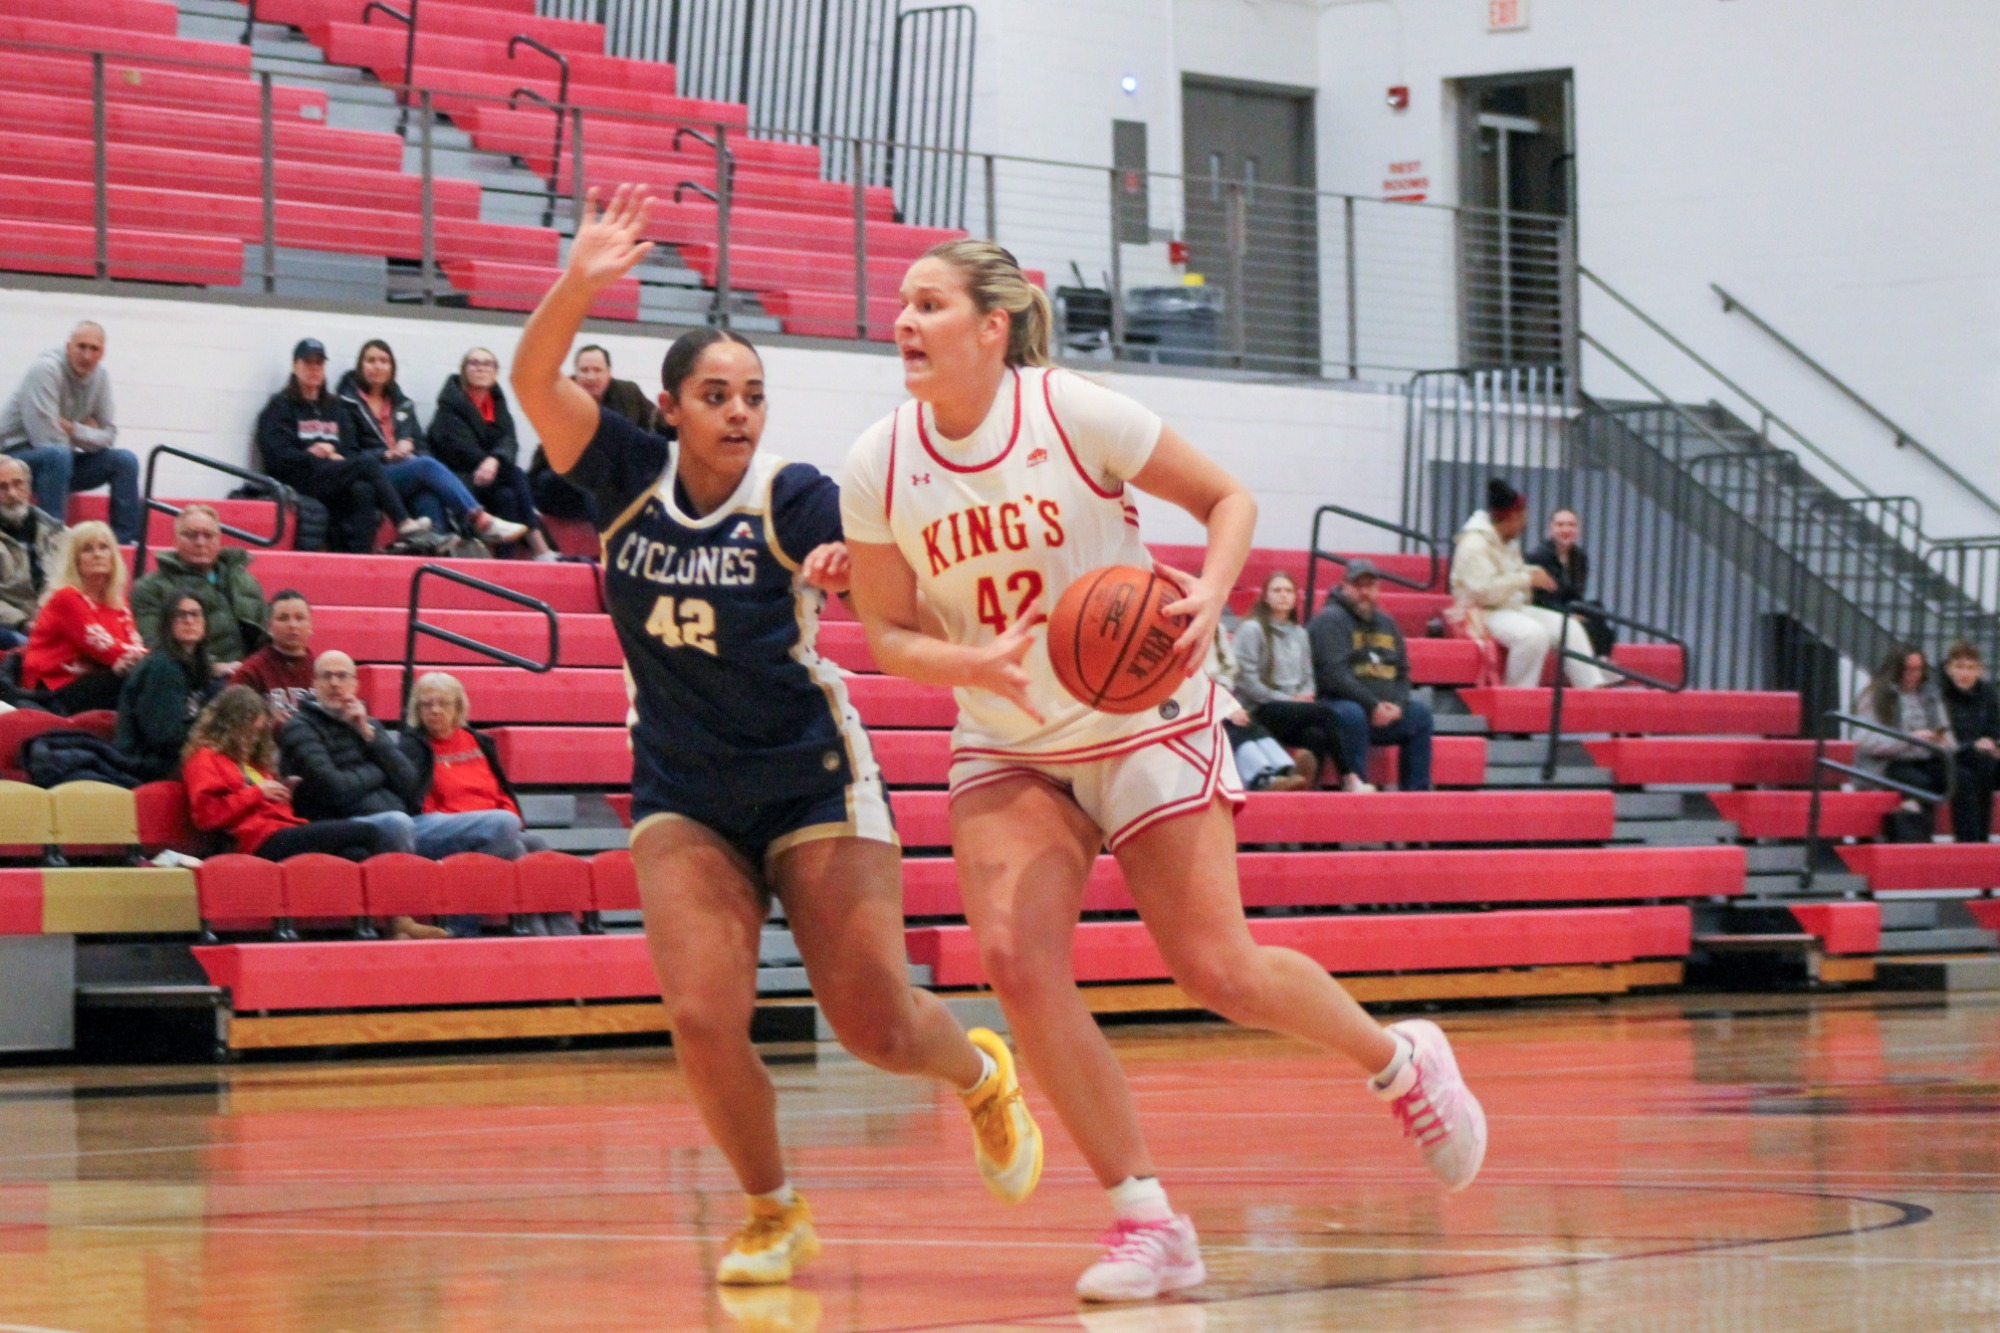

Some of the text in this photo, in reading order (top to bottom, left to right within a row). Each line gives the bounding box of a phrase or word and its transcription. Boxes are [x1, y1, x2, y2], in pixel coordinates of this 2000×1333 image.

[615, 532, 758, 586] CYCLONES
[921, 494, 1065, 577] KING'S
[644, 595, 718, 656] 42
[977, 569, 1048, 635] 42
